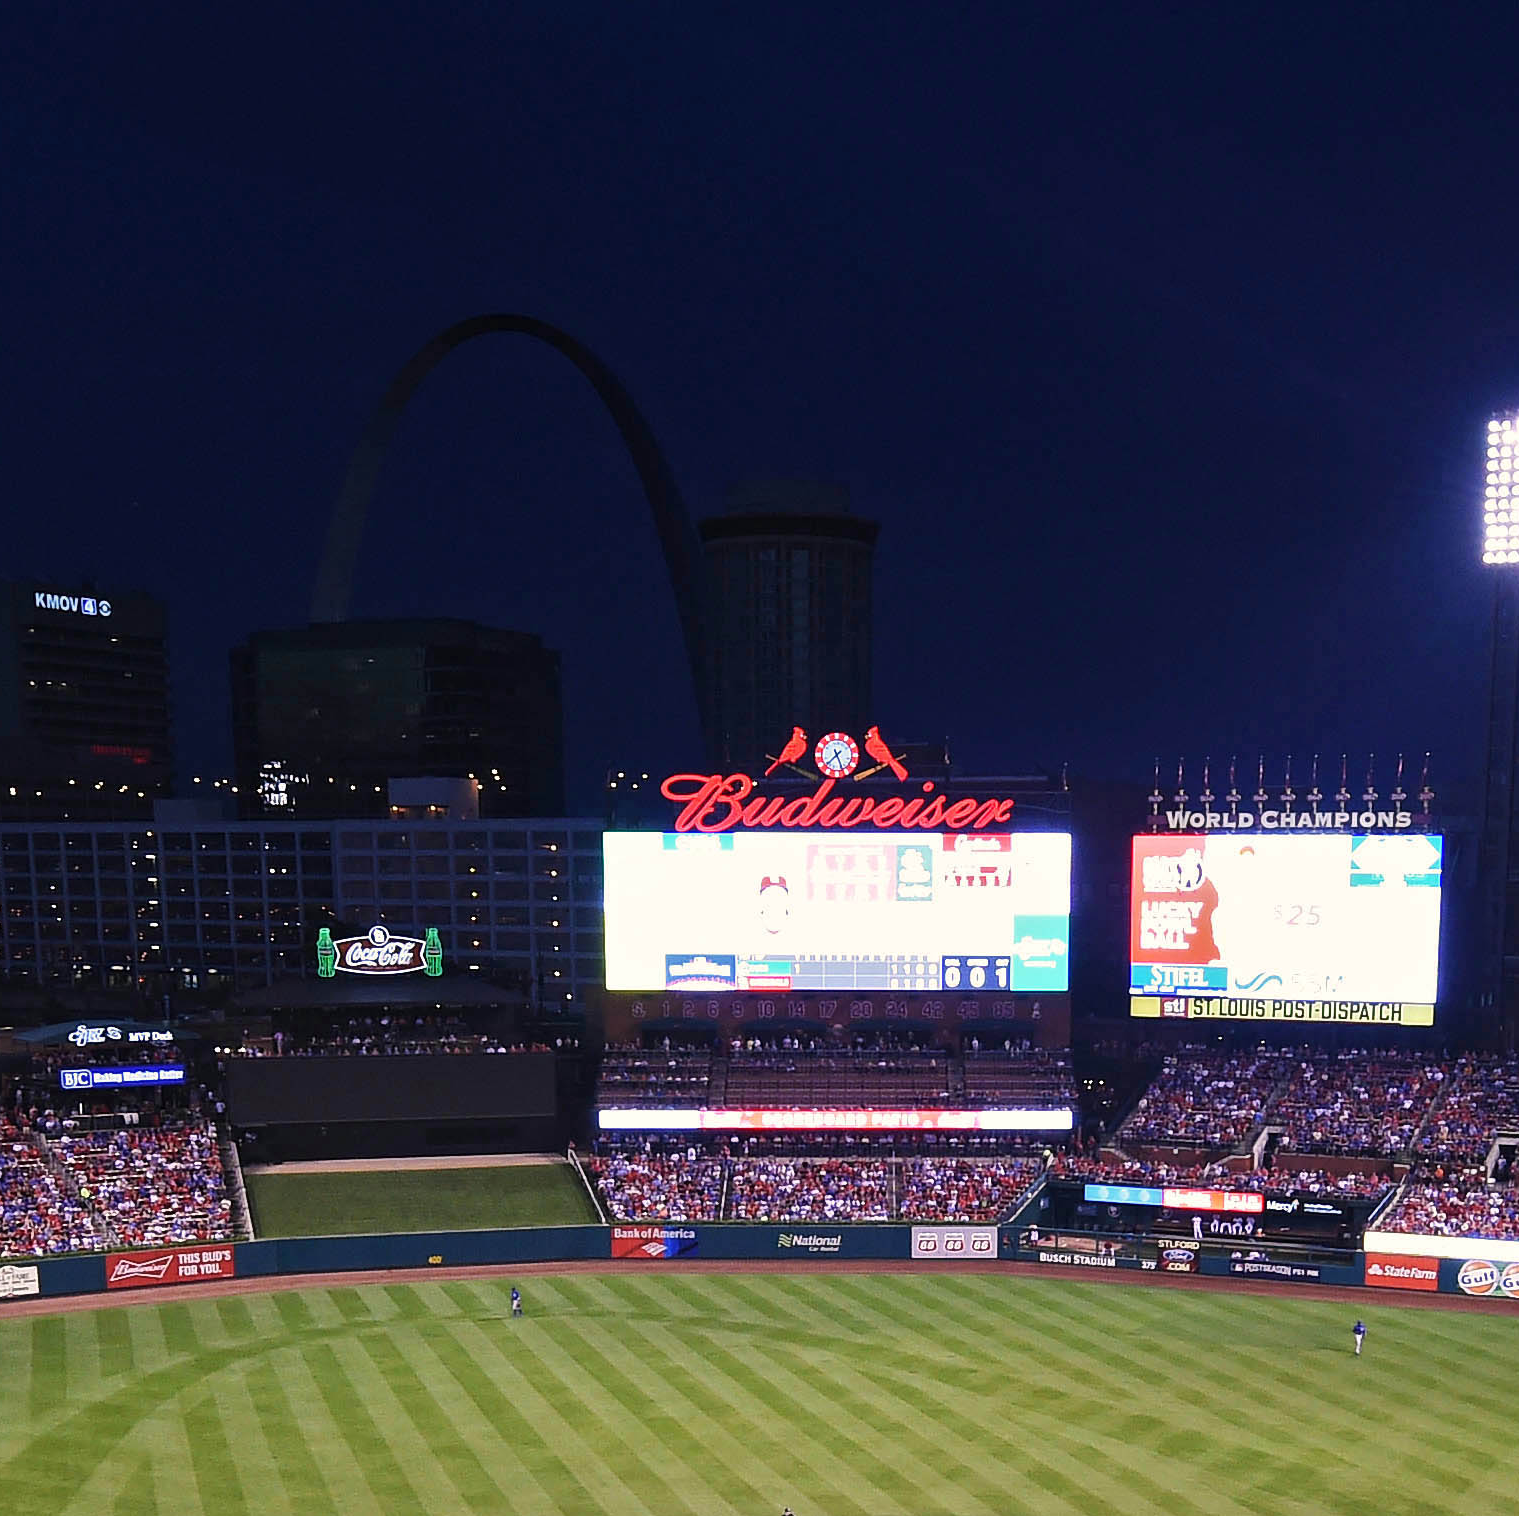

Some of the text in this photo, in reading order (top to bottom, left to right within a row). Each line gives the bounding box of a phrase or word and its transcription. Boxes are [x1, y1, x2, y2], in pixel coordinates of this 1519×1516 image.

[35, 592, 79, 612] KMOV
[660, 774, 1014, 832] Budweiser
[1166, 810, 1412, 829] WORLD CHAMPIONS
[945, 966, 1007, 988] 0 0 1
[1193, 999, 1402, 1022] ST. LOUIS POST-DISPATCH
[64, 1072, 89, 1086] BJC
[1266, 1200, 1293, 1214] Mercy
[614, 1228, 695, 1239] Bank of America
[792, 1235, 842, 1246] National
[177, 1250, 231, 1265] THIS BUD'S
[1039, 1252, 1116, 1267] BUSCH STADIUM
[178, 1263, 223, 1276] FOR YOU.
[1461, 1268, 1496, 1286] Gulf
